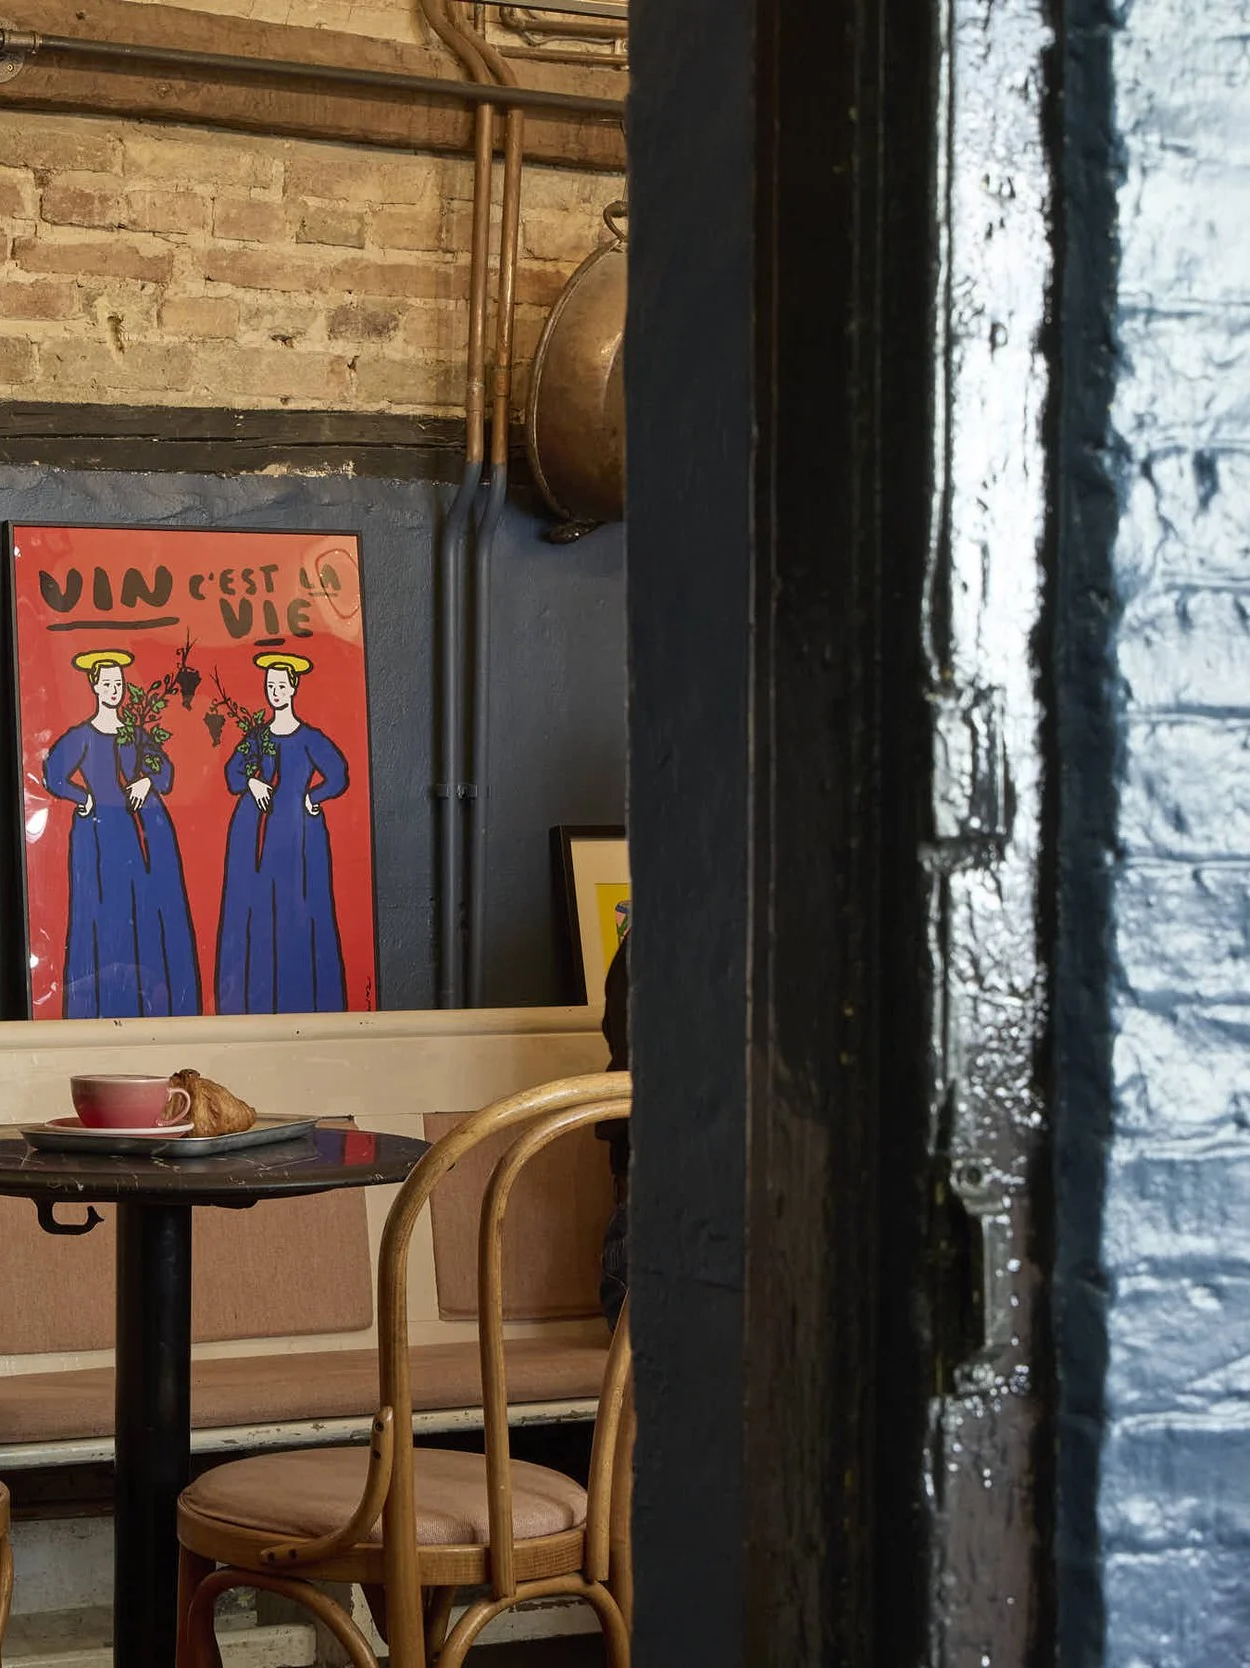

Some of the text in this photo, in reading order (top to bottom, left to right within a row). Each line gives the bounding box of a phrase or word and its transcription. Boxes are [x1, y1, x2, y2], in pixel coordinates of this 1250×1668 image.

[39, 564, 341, 612] VIN C'EST LA
[219, 597, 313, 638] VIE
